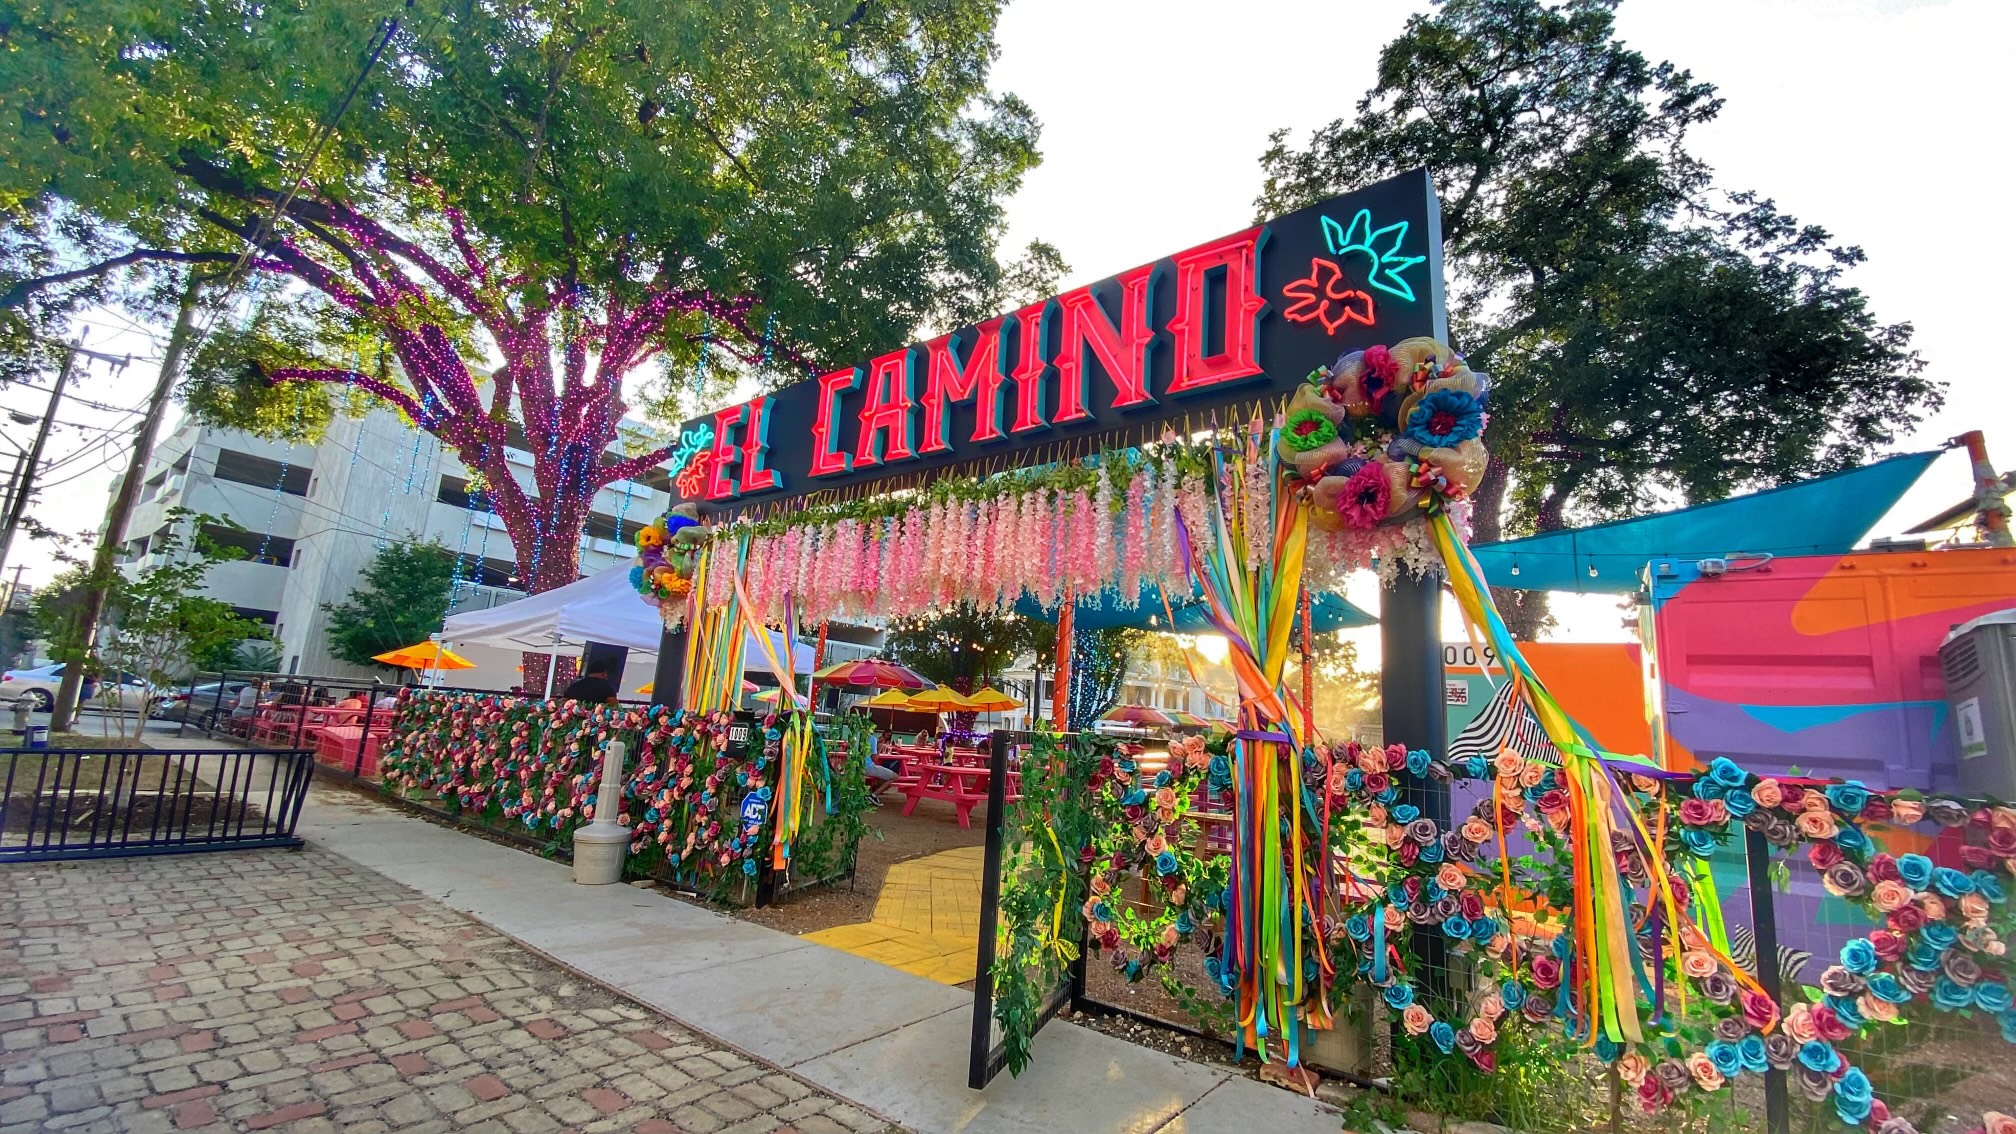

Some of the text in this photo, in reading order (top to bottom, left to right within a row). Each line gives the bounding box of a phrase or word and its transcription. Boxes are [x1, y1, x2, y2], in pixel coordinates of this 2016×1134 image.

[704, 225, 1272, 500] EL CAMINO
[730, 727, 748, 740] 1009
[744, 803, 765, 820] ADT
